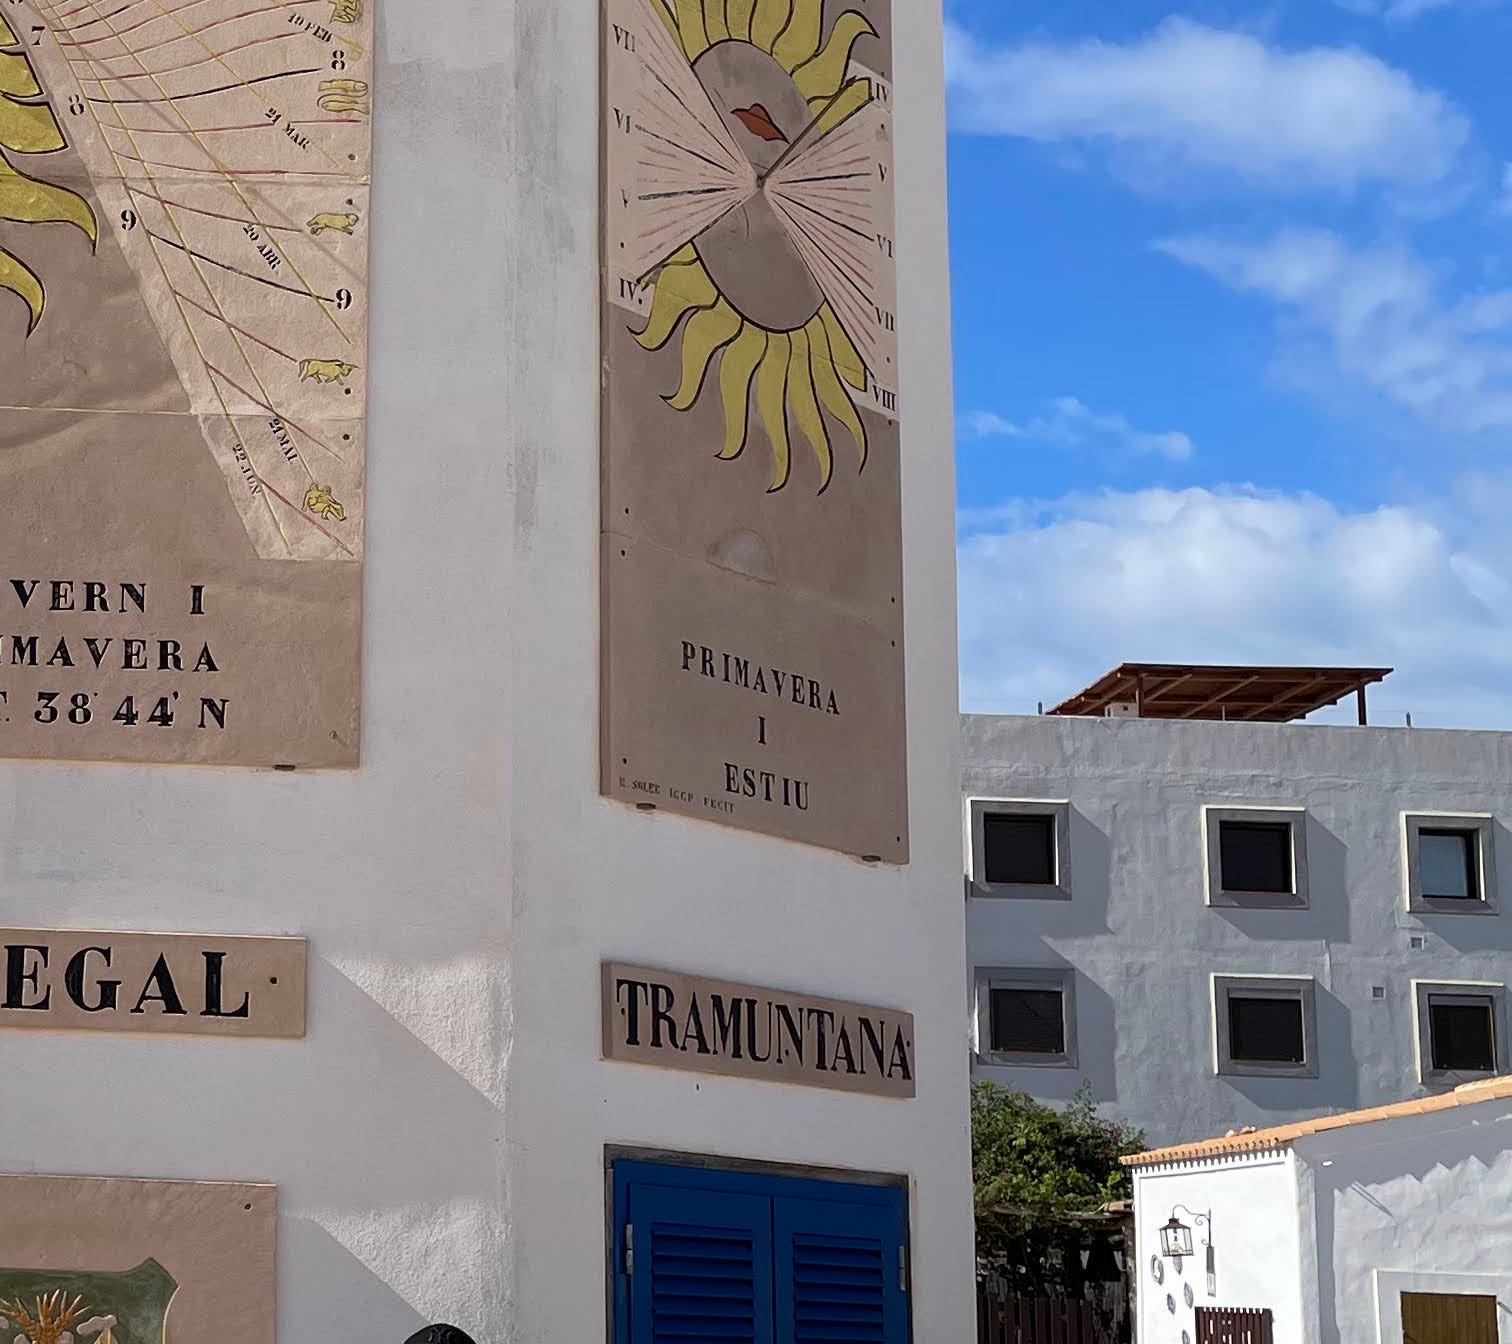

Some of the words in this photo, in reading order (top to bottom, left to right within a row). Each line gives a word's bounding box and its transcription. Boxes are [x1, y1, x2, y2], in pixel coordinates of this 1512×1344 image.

[31, 26, 45, 46] 7
[331, 50, 346, 71] 8
[68, 94, 85, 116] 8
[613, 107, 631, 134] VI
[877, 162, 887, 183] V
[120, 208, 137, 231] 9
[876, 234, 893, 259] VI
[336, 288, 352, 310] 9
[875, 306, 895, 332] VII
[872, 384, 897, 412] VIII
[189, 583, 206, 615] I
[680, 640, 841, 716] PRIMAVERA
[198, 698, 229, 730] N
[758, 717, 767, 745] I
[724, 762, 810, 812] ESTIU
[616, 978, 913, 1081] TRAMUNTANA
